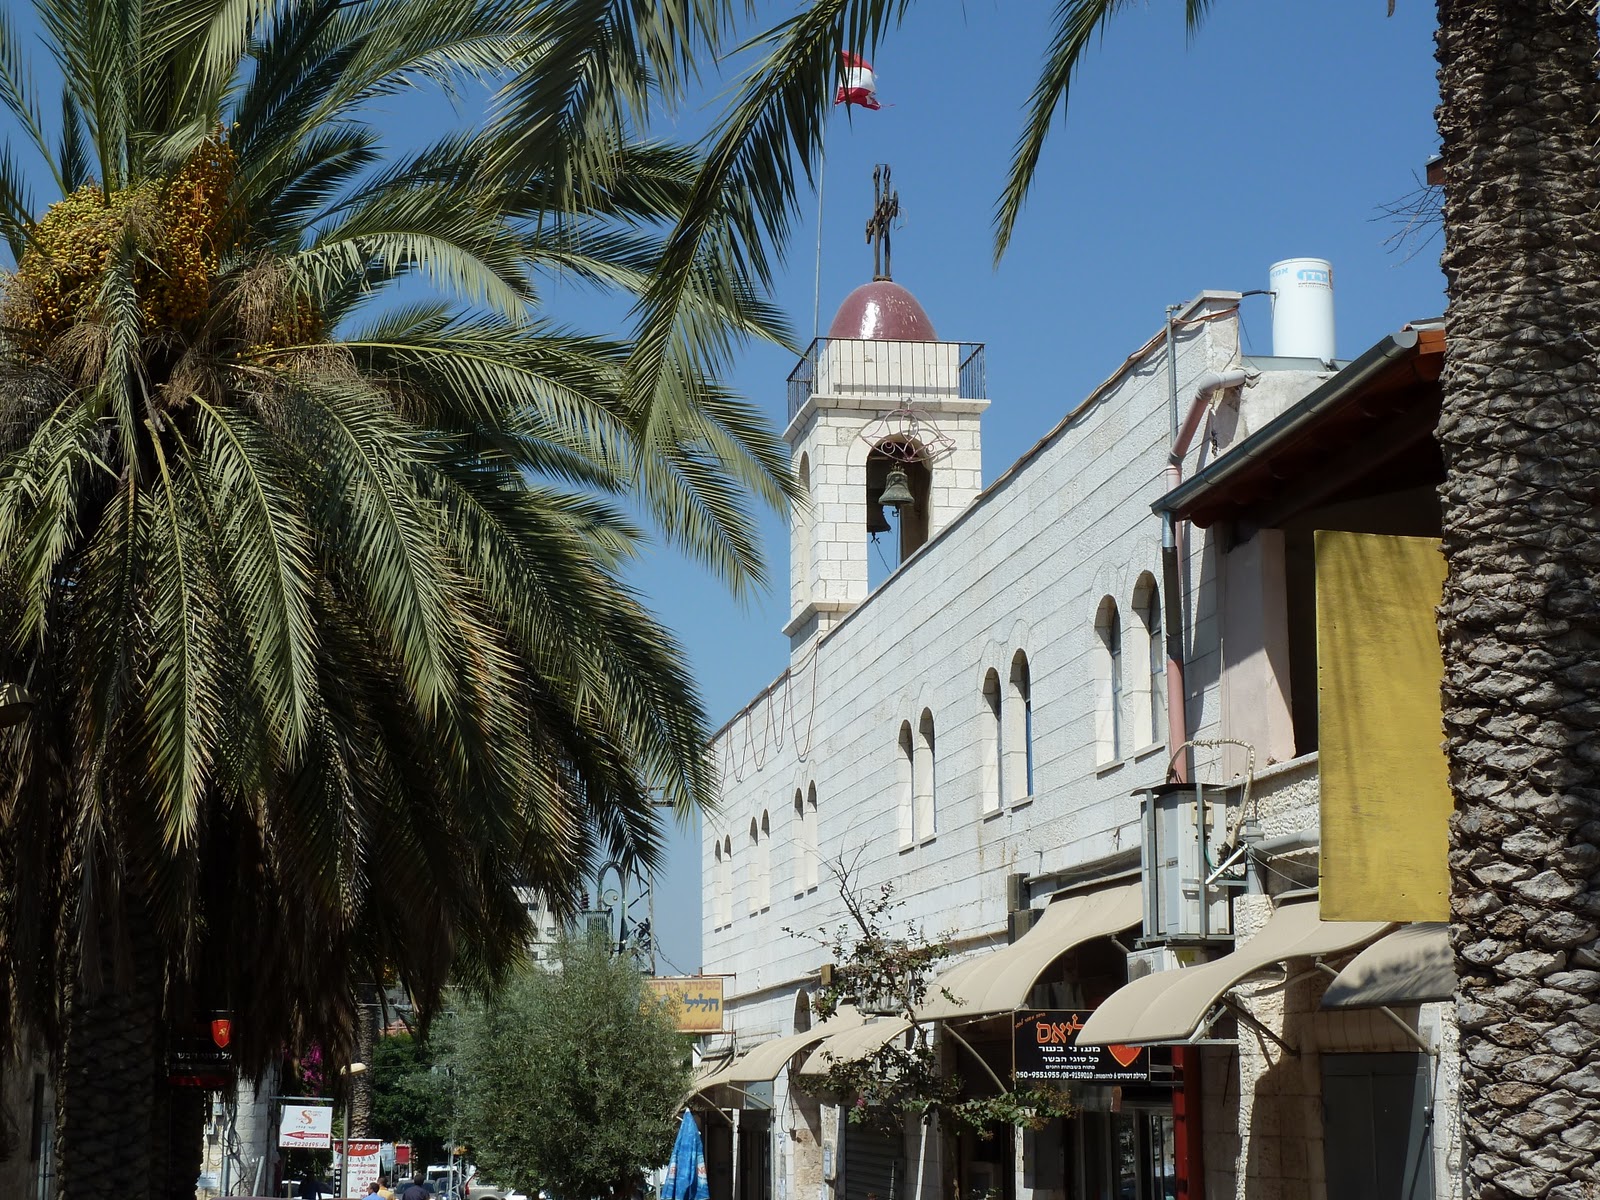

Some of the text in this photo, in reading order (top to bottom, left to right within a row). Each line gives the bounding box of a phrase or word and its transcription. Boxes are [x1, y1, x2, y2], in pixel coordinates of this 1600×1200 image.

[684, 981, 720, 991] מסעדה
[683, 993, 719, 1013] חליל
[1035, 1013, 1084, 1044] ליאס
